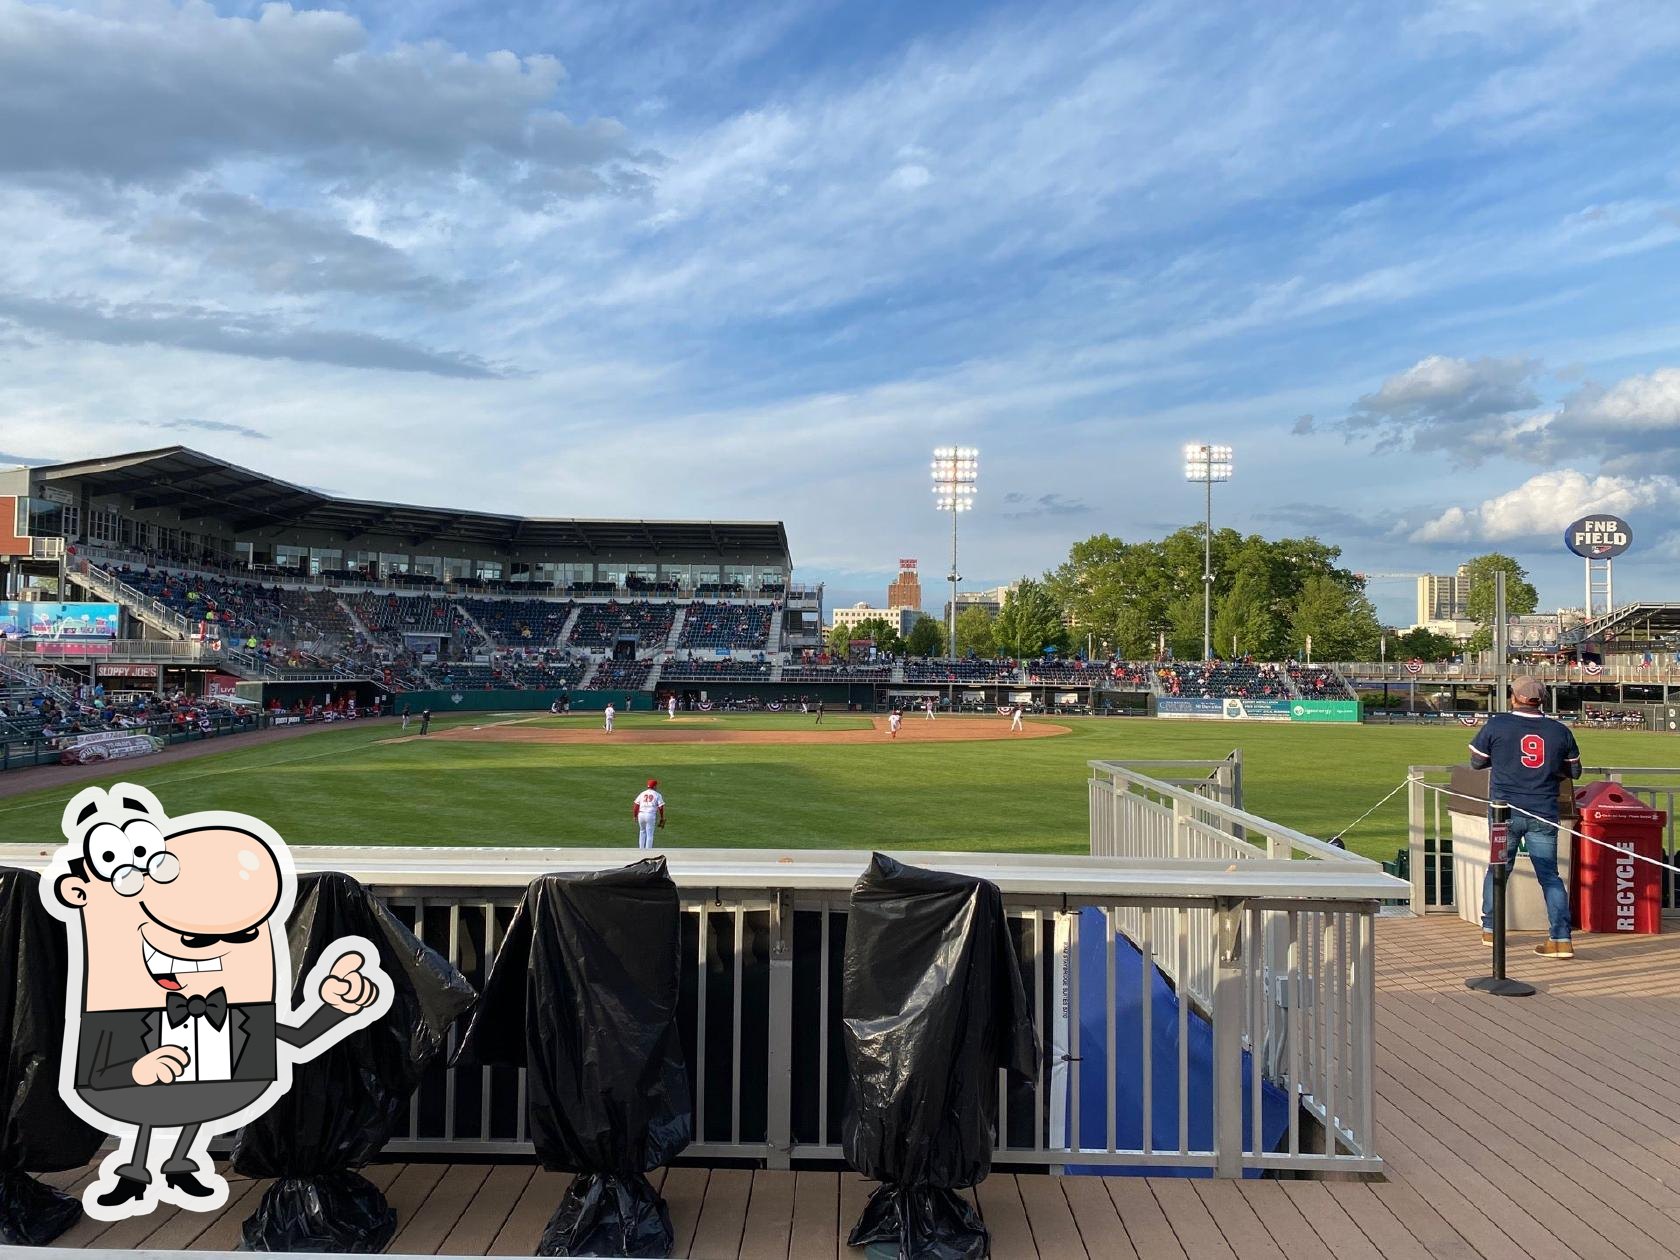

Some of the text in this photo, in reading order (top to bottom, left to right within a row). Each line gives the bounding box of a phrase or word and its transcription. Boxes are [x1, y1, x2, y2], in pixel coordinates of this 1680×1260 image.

[1585, 520, 1618, 532] FNB
[1575, 532, 1627, 546] FIELD
[98, 666, 157, 677] SLOPPY JOE'S
[1520, 734, 1545, 769] 9
[1616, 841, 1635, 931] RECYCLE
